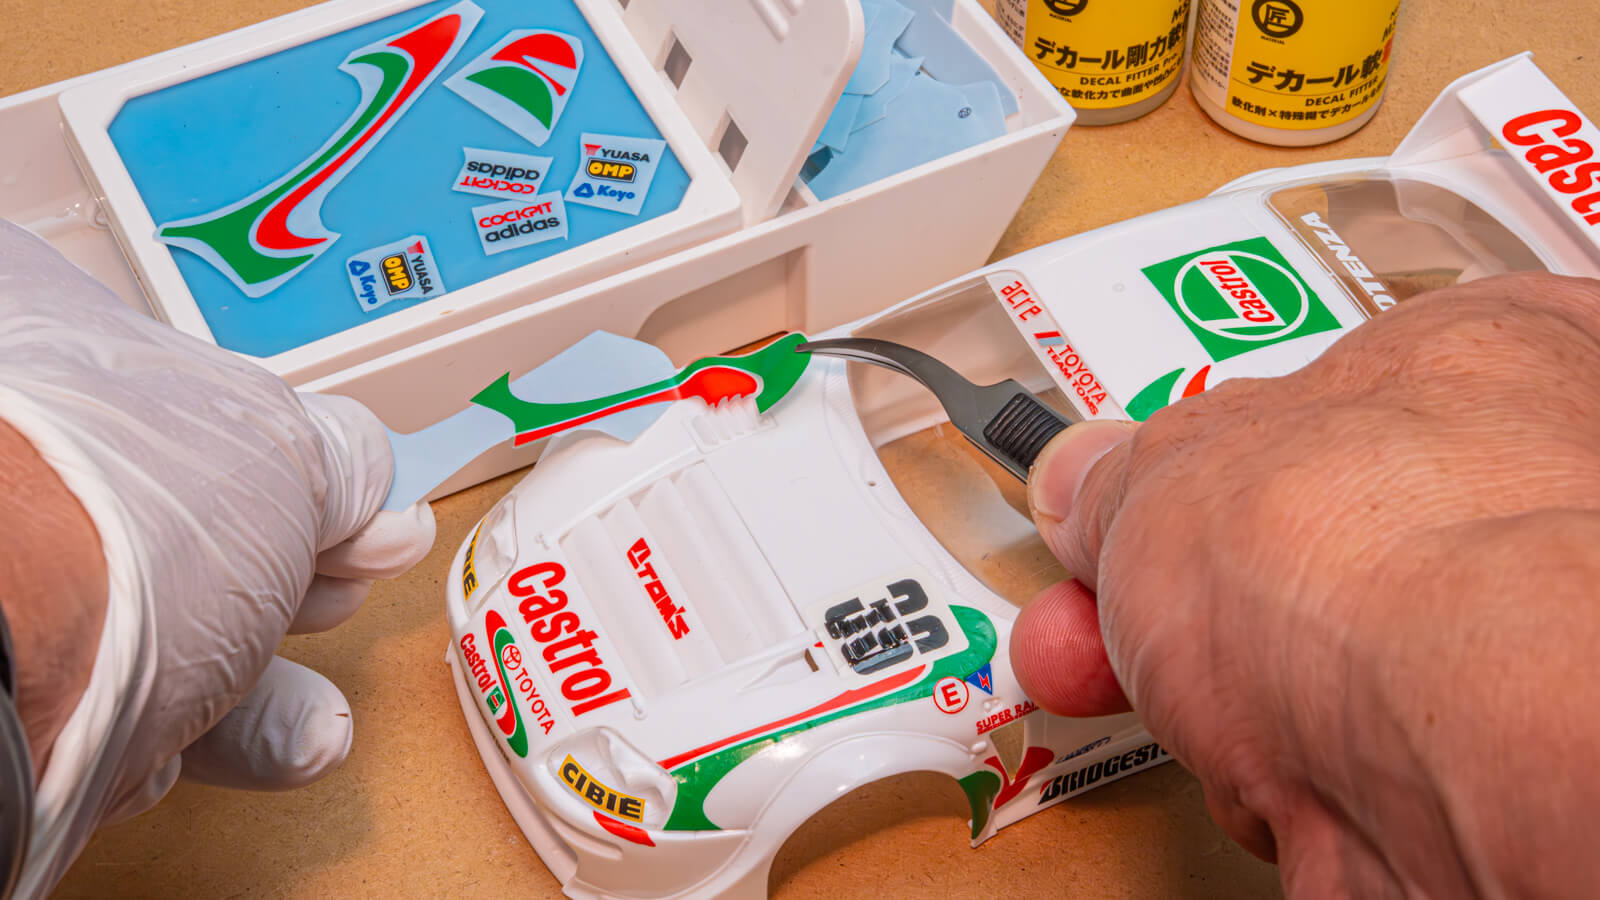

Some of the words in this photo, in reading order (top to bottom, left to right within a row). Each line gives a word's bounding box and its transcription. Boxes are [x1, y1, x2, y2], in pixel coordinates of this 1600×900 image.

[1265, 4, 1290, 25] 匠
[1034, 23, 1184, 70] デカール剛力軟
[1080, 76, 1121, 86] DECAL
[1126, 64, 1159, 83] FITTER
[1305, 94, 1345, 107] DECAL
[467, 161, 540, 181] adidas
[588, 161, 634, 178] OMP
[601, 148, 650, 163] YUASA
[1502, 109, 1600, 226] Cas
[460, 176, 535, 194] COCKPIT
[597, 184, 635, 201] Koyo
[479, 201, 552, 228] COCKPIT
[485, 216, 560, 242] adidas
[360, 274, 378, 304] Koyo
[384, 256, 410, 290] OMP
[411, 255, 433, 295] YUASA
[1200, 260, 1275, 323] Castrol
[1047, 345, 1072, 380] TEAM
[1059, 344, 1107, 404] TOYOTA
[637, 561, 690, 640] TOM'S
[507, 561, 632, 717] Castrol
[460, 633, 497, 693] Castrol
[515, 667, 555, 735] TOYOTA
[976, 708, 1014, 731] SUPER
[1014, 700, 1036, 715] RA
[563, 762, 642, 820] CIBIE
